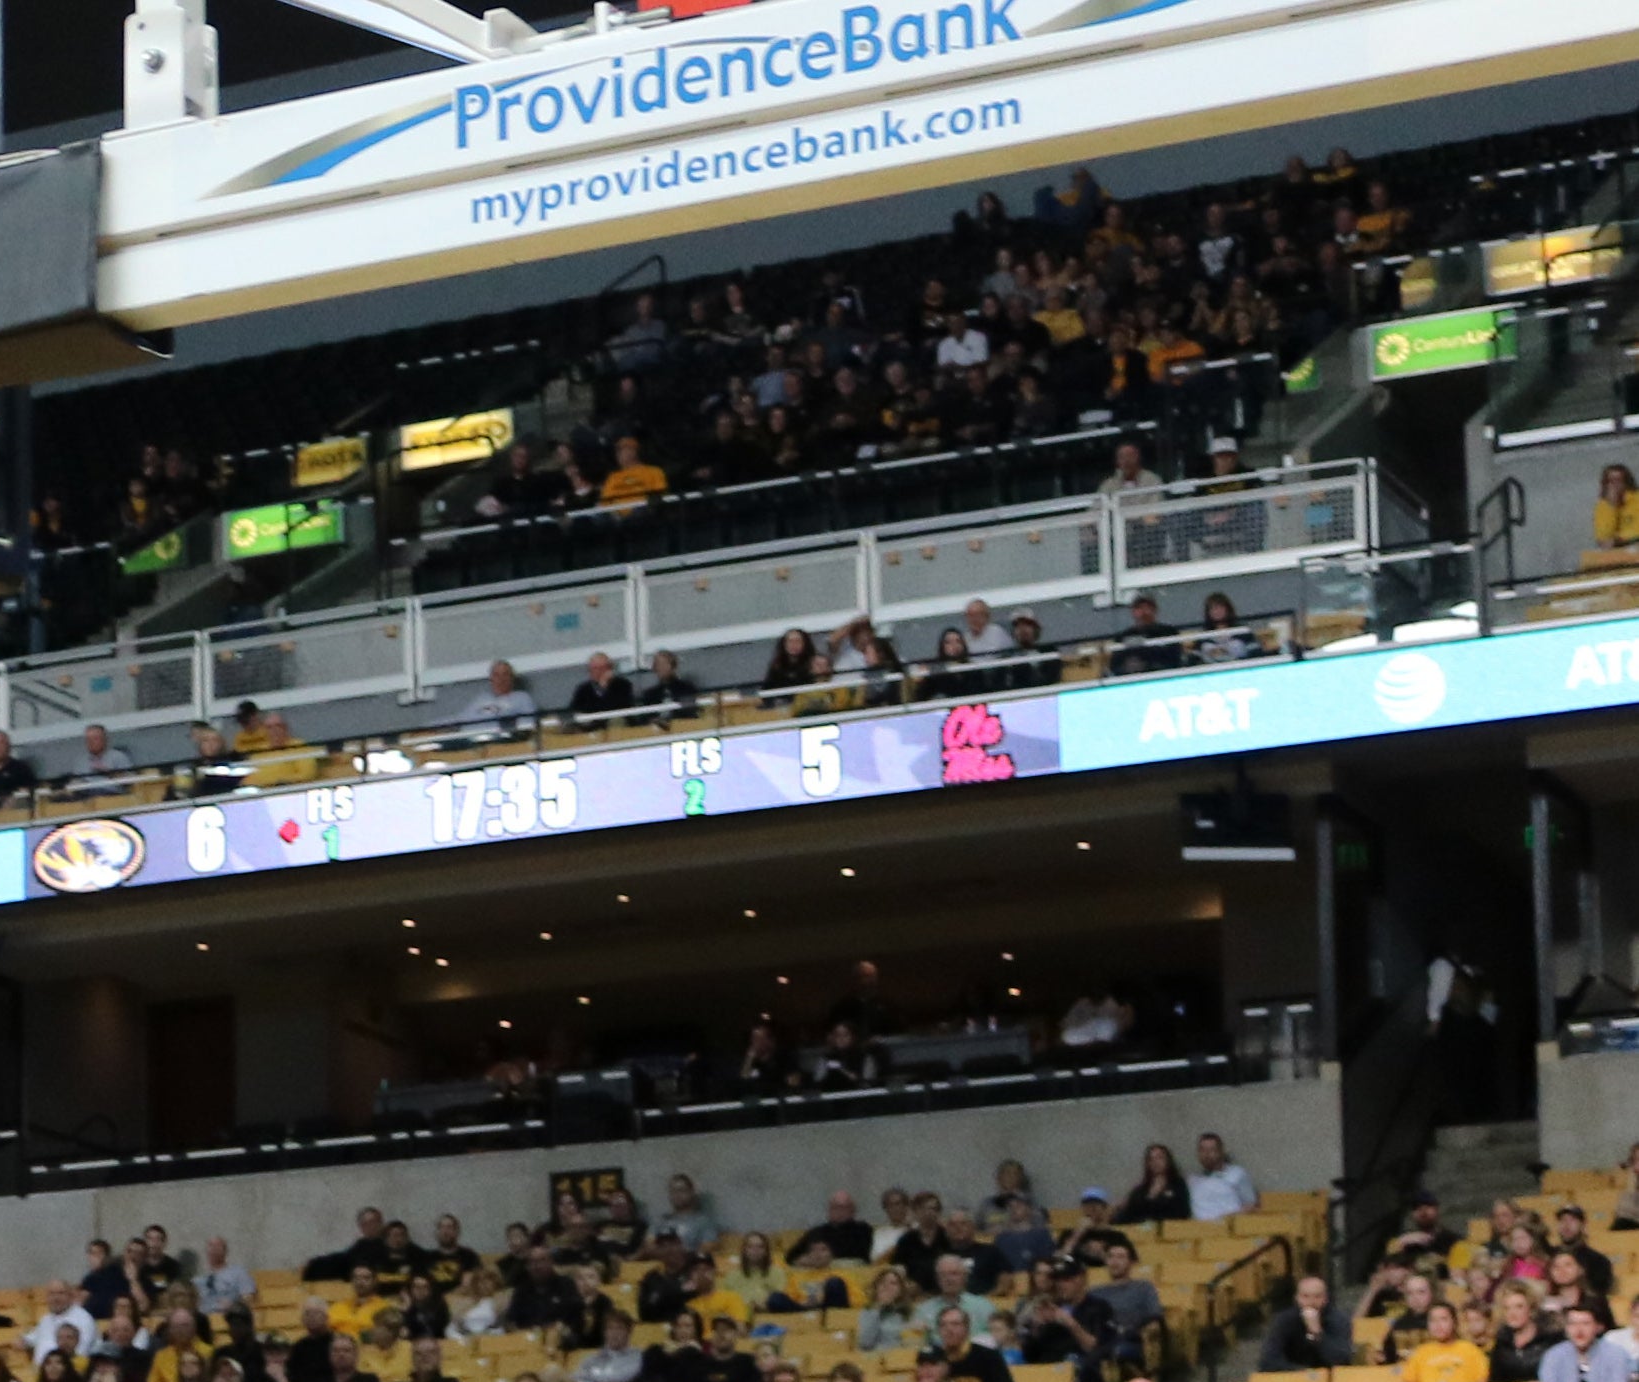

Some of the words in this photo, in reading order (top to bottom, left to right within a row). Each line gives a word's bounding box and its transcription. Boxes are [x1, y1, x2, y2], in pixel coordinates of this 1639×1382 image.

[454, 0, 1023, 149] ProvidenceBank
[471, 98, 1022, 226] myprovidencebank.com
[1139, 687, 1259, 742] AT&T
[670, 737, 723, 778] FLS
[800, 724, 841, 798] 5
[307, 786, 354, 824] FLS
[425, 759, 578, 844] 17:35
[684, 778, 706, 816] 2
[186, 805, 227, 874] 6
[323, 824, 340, 861] 1
